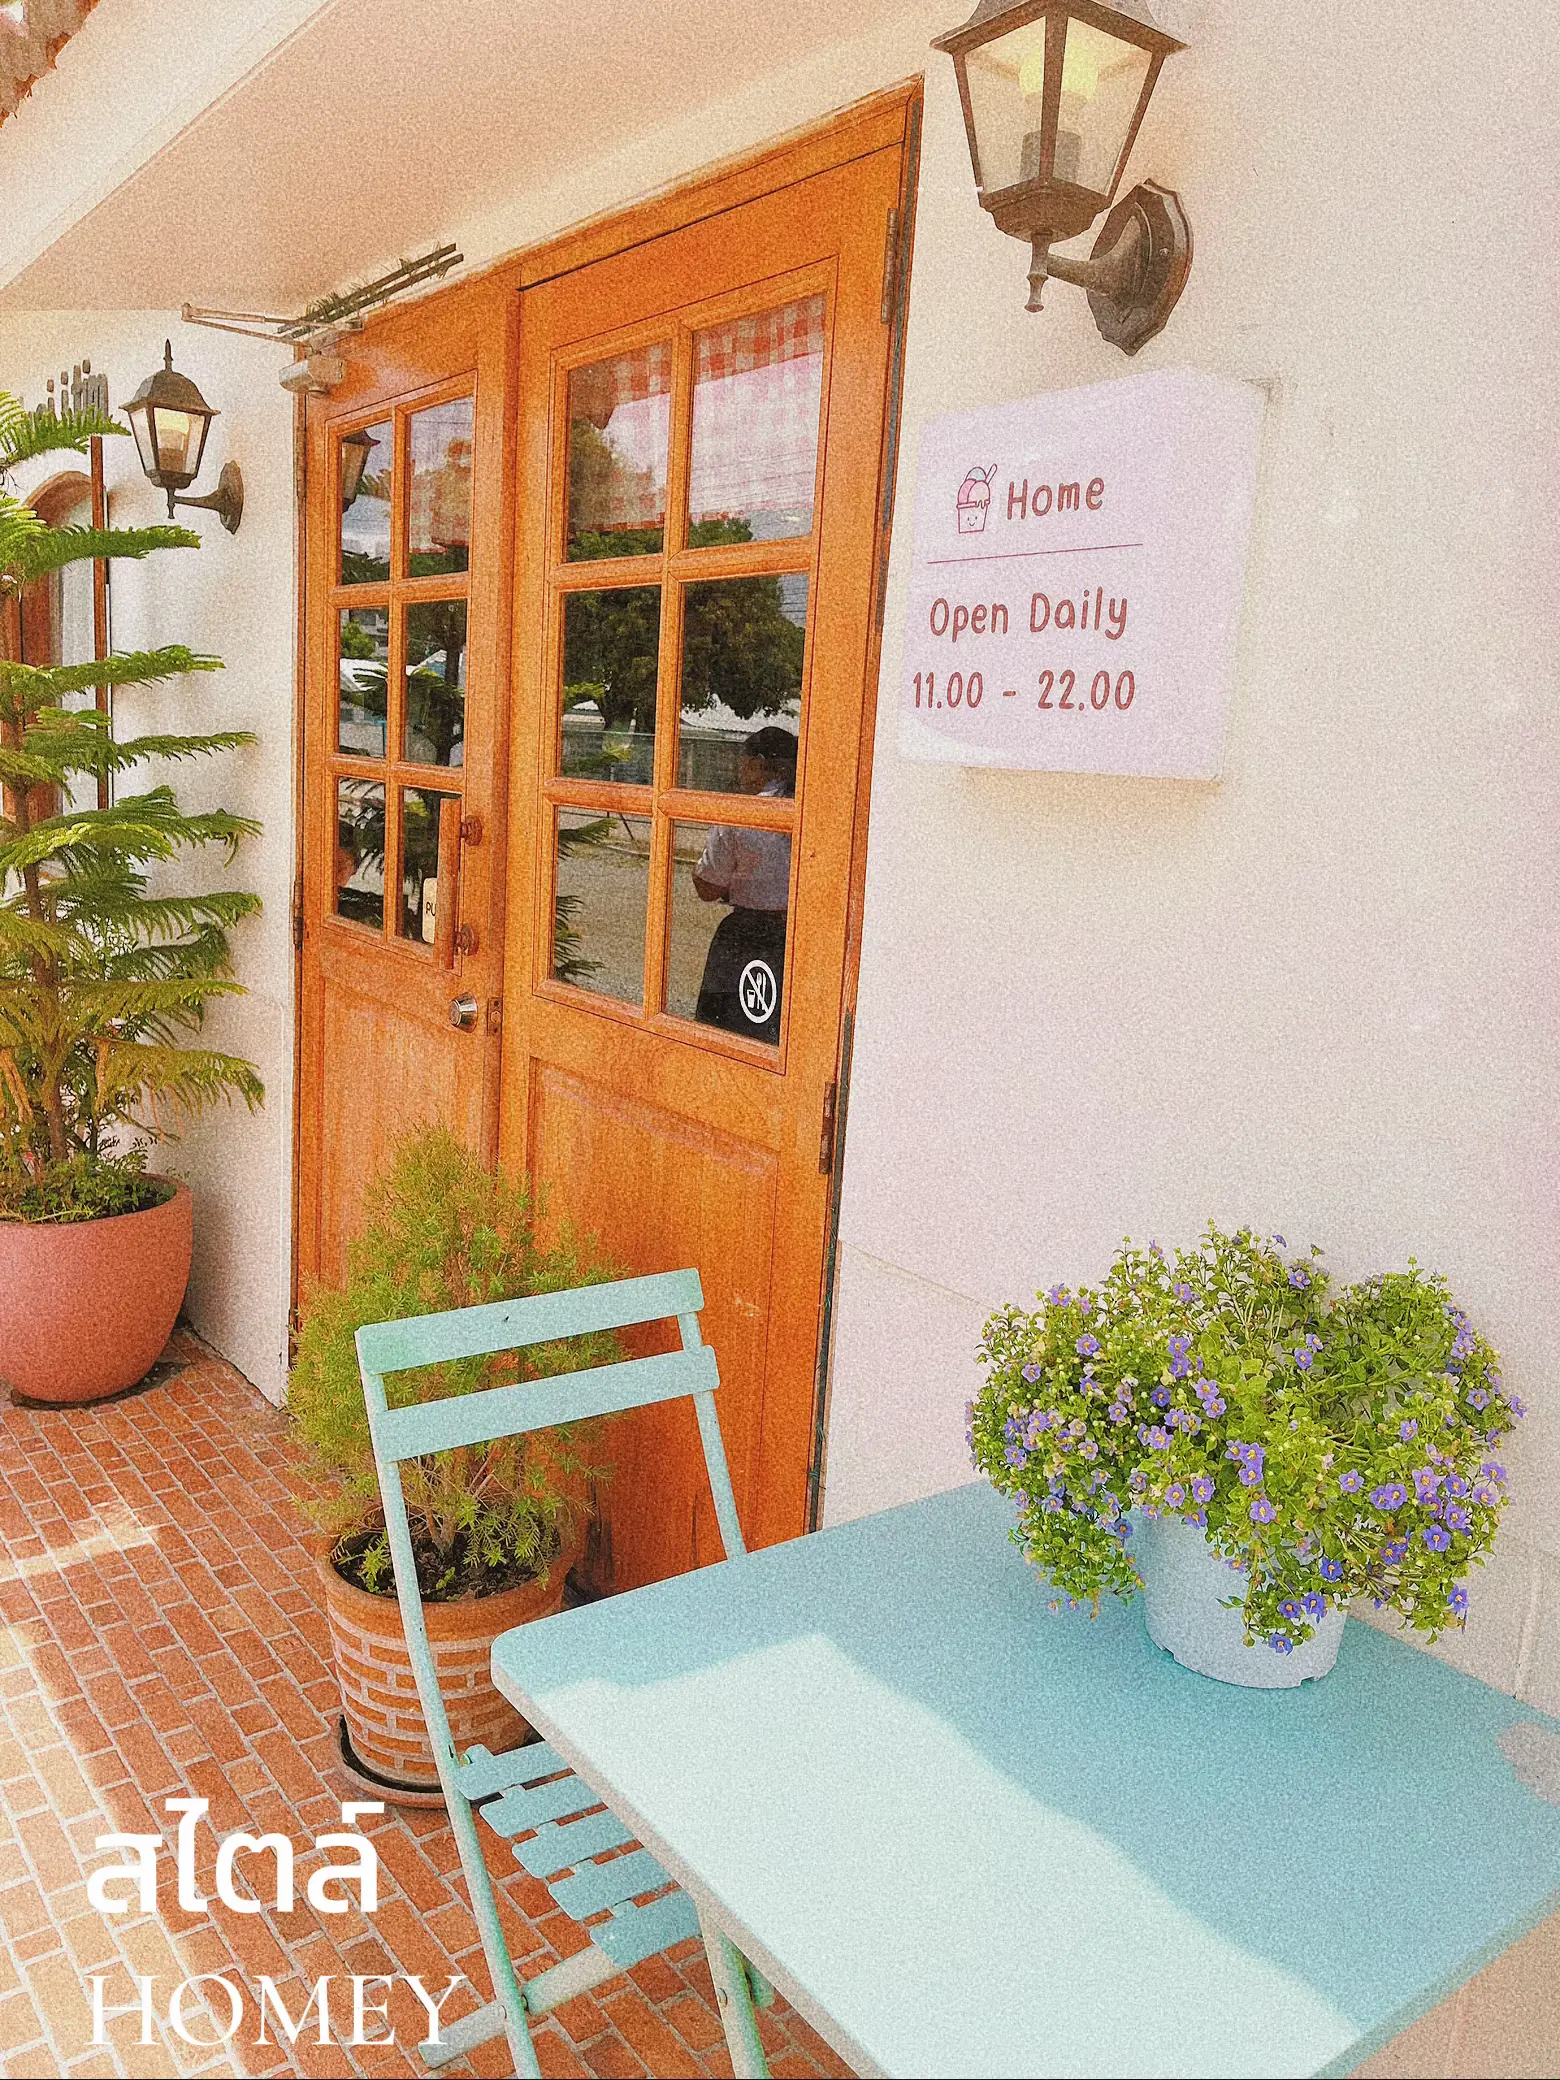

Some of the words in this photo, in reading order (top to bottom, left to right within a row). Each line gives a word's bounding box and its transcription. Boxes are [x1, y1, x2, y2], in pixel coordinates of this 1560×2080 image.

[1007, 478, 1105, 520] Home
[929, 598, 1010, 643] Open
[1029, 587, 1128, 641] Daily
[912, 671, 984, 709] 11.00
[1037, 669, 1136, 711] 22.00
